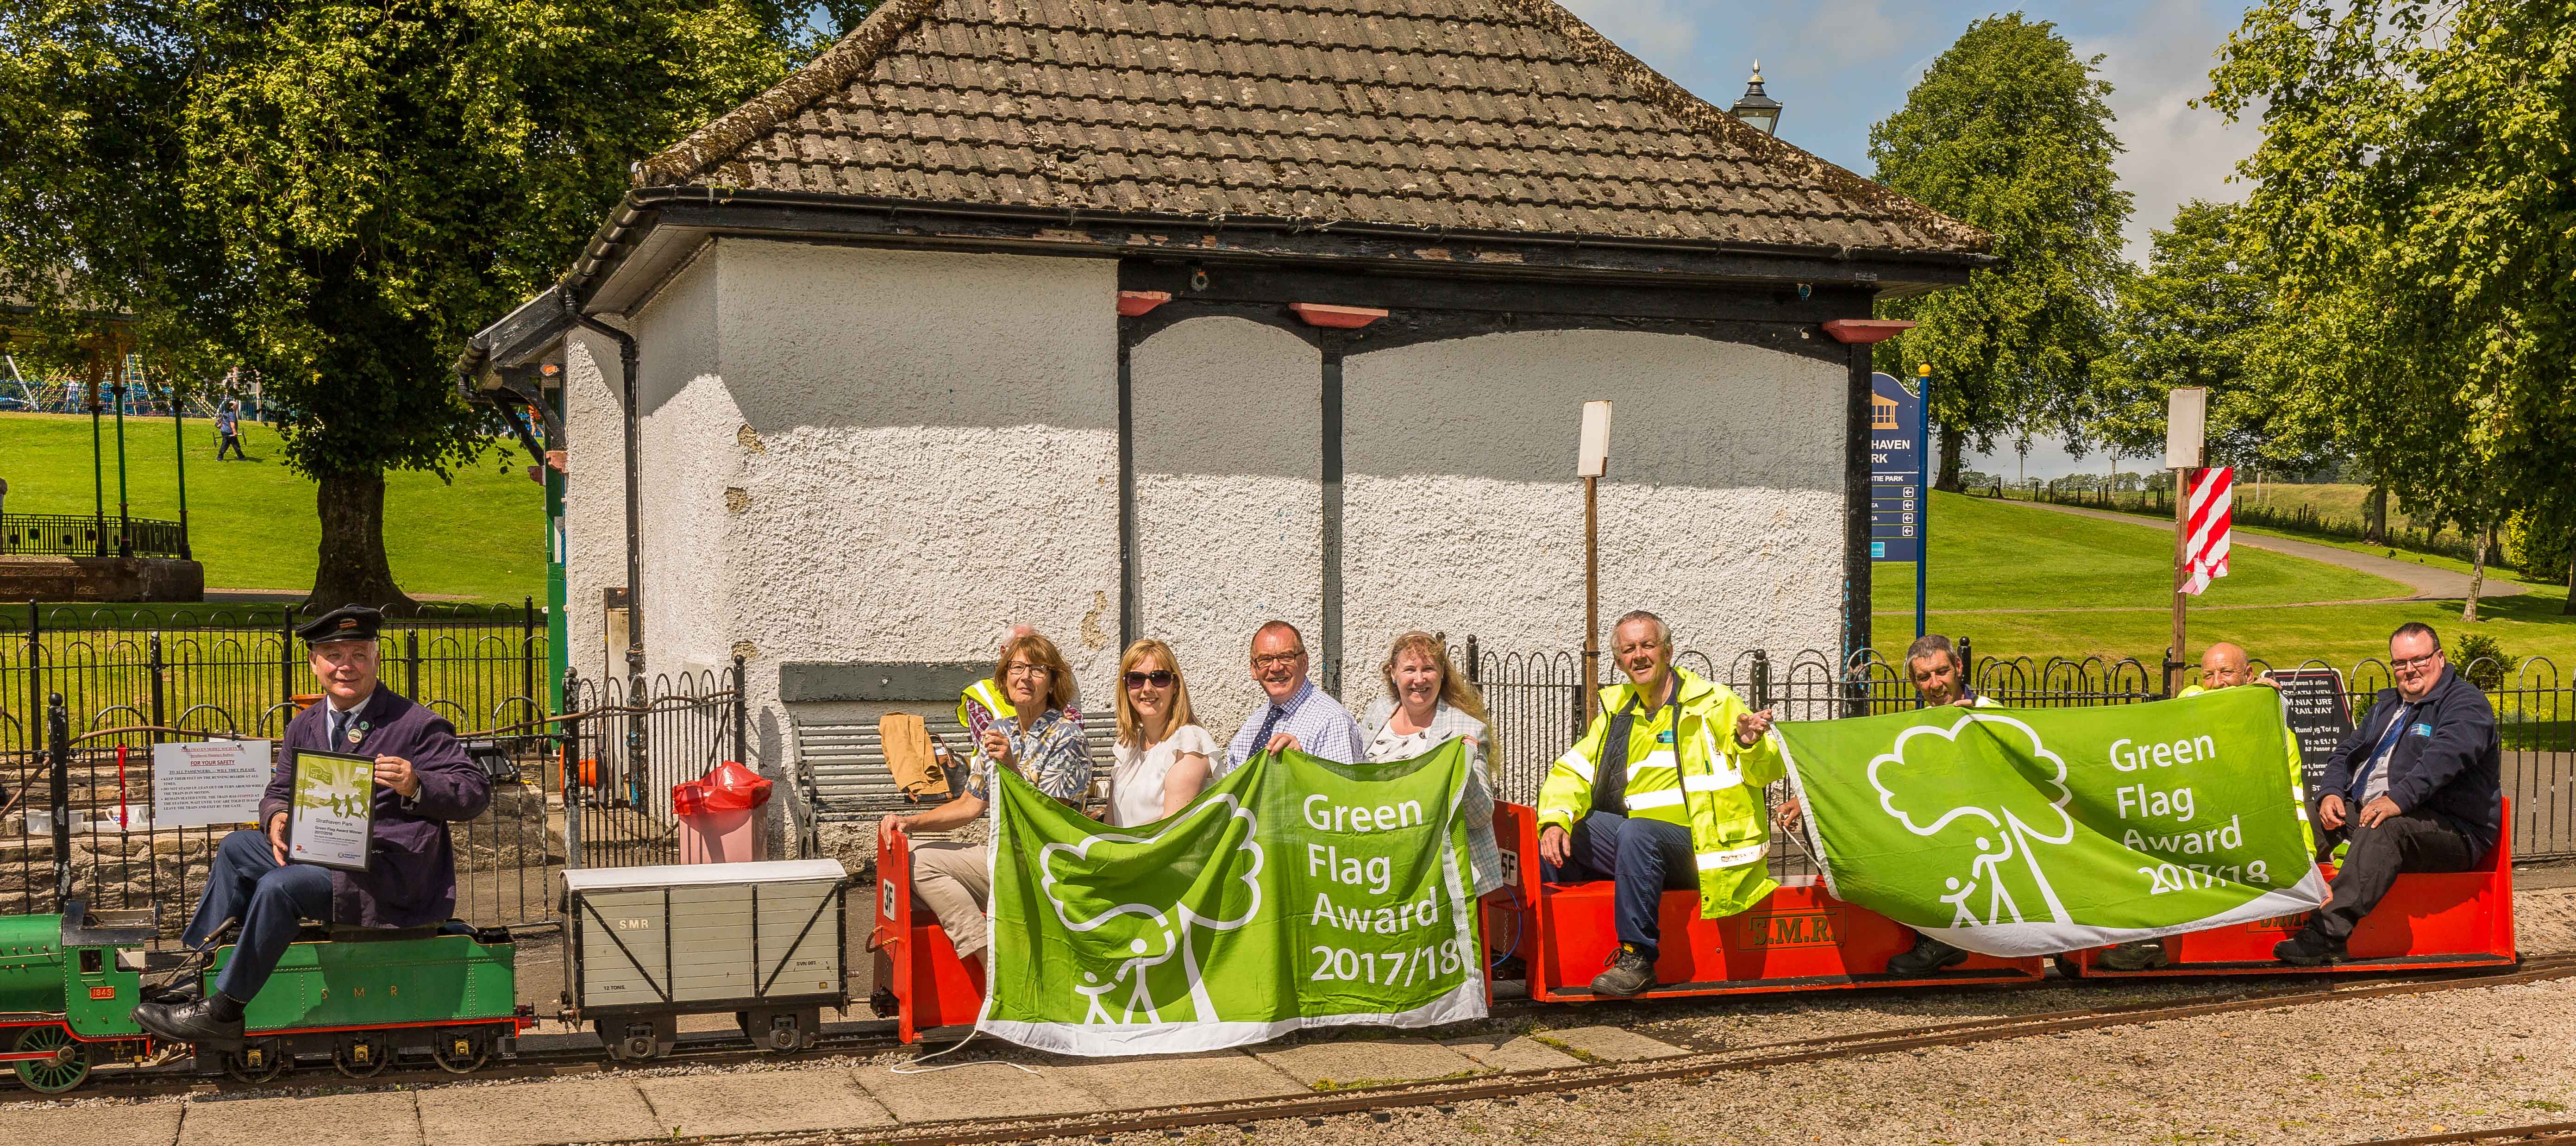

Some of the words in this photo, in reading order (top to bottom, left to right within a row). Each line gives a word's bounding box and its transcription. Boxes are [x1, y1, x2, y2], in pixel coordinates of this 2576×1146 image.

[2109, 734, 2216, 772] Green
[1304, 794, 1423, 832] Green
[2116, 783, 2195, 822] Flag
[2123, 814, 2244, 855] Award
[1307, 842, 1391, 895] Flag
[1501, 852, 1516, 879] 5F
[2137, 859, 2270, 895] 2017/18
[884, 883, 893, 913] 3F
[1310, 886, 1439, 934] Award
[1753, 916, 1836, 945] S.M.R.
[1310, 938, 1460, 987] 2017/18
